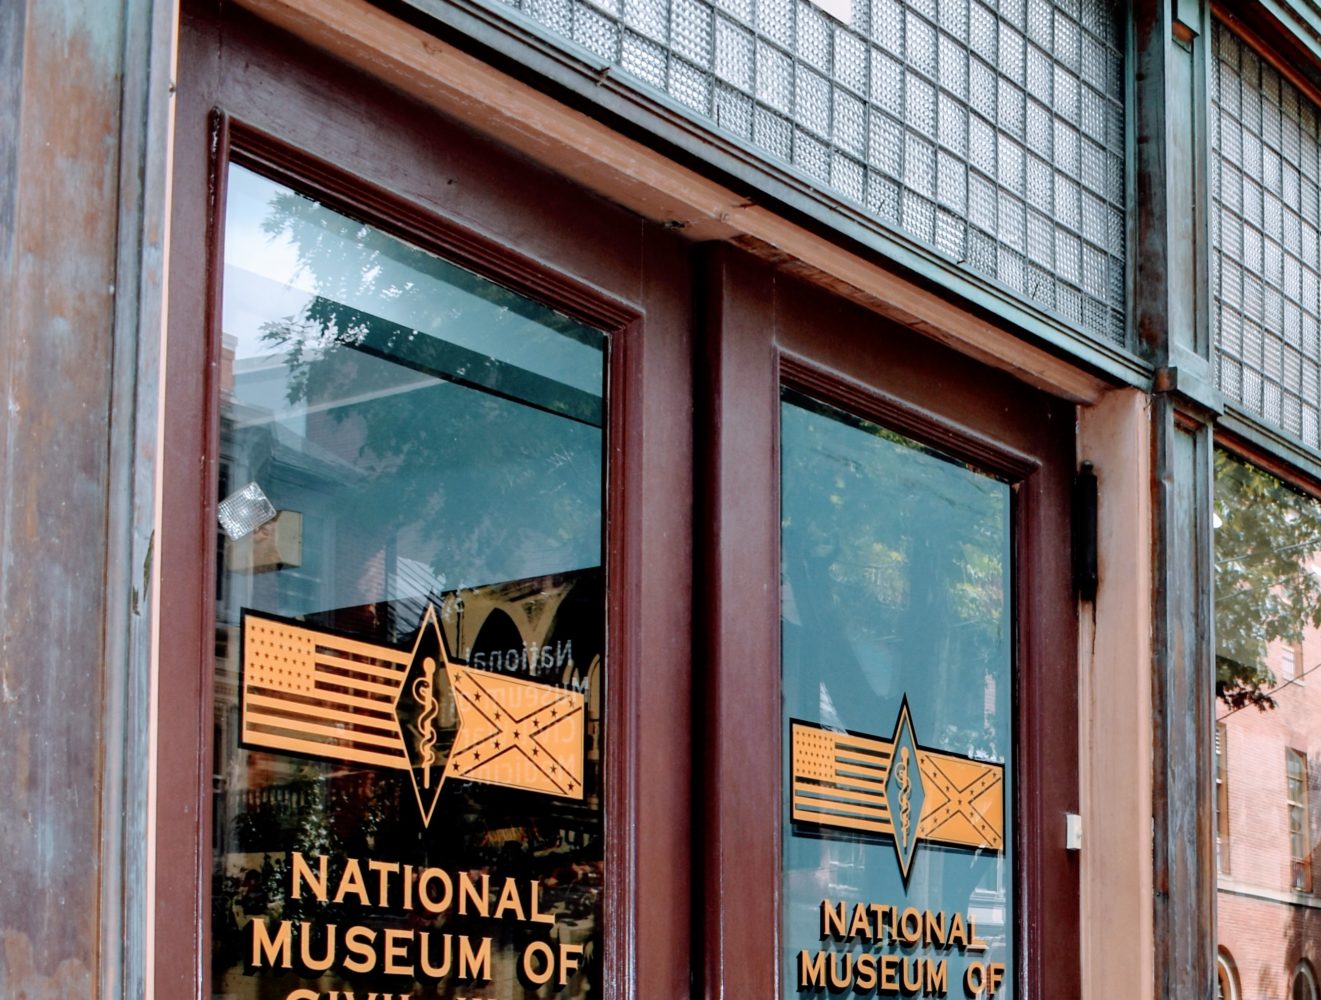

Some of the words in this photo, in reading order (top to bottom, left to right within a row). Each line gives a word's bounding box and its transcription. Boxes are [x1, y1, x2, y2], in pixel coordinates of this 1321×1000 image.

[291, 852, 555, 925] NATIONAL
[252, 919, 492, 981] MUSEUM
[523, 940, 584, 985] OF
[822, 899, 988, 948] NATIONAL
[800, 949, 948, 993] MUSEUM
[966, 962, 1006, 995] OF
